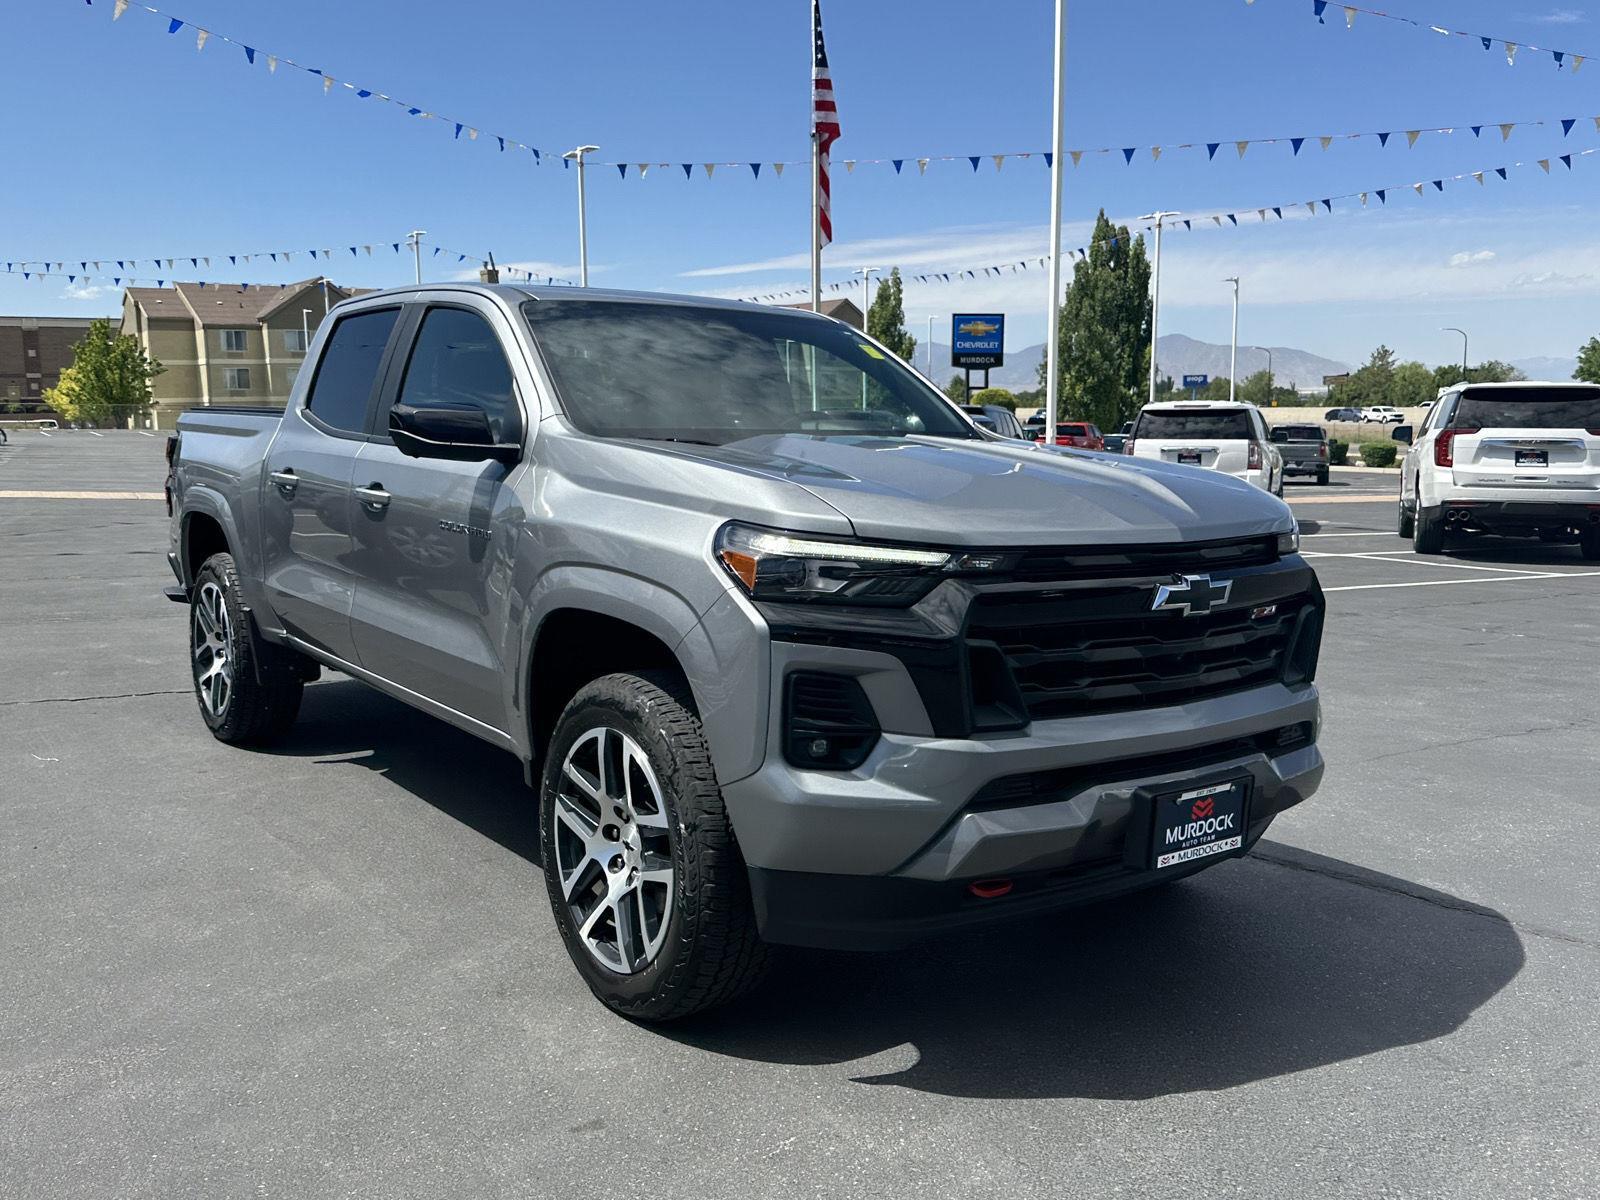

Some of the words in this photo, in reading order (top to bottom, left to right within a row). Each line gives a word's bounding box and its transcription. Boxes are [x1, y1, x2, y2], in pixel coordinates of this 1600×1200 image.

[956, 341, 999, 349] CHEVROLET
[960, 356, 995, 364] MURDOCK
[1165, 813, 1234, 845] MURDOCK
[1182, 838, 1199, 848] AUTO
[1200, 834, 1216, 843] TEAM
[1177, 842, 1223, 861] MURDOCK
